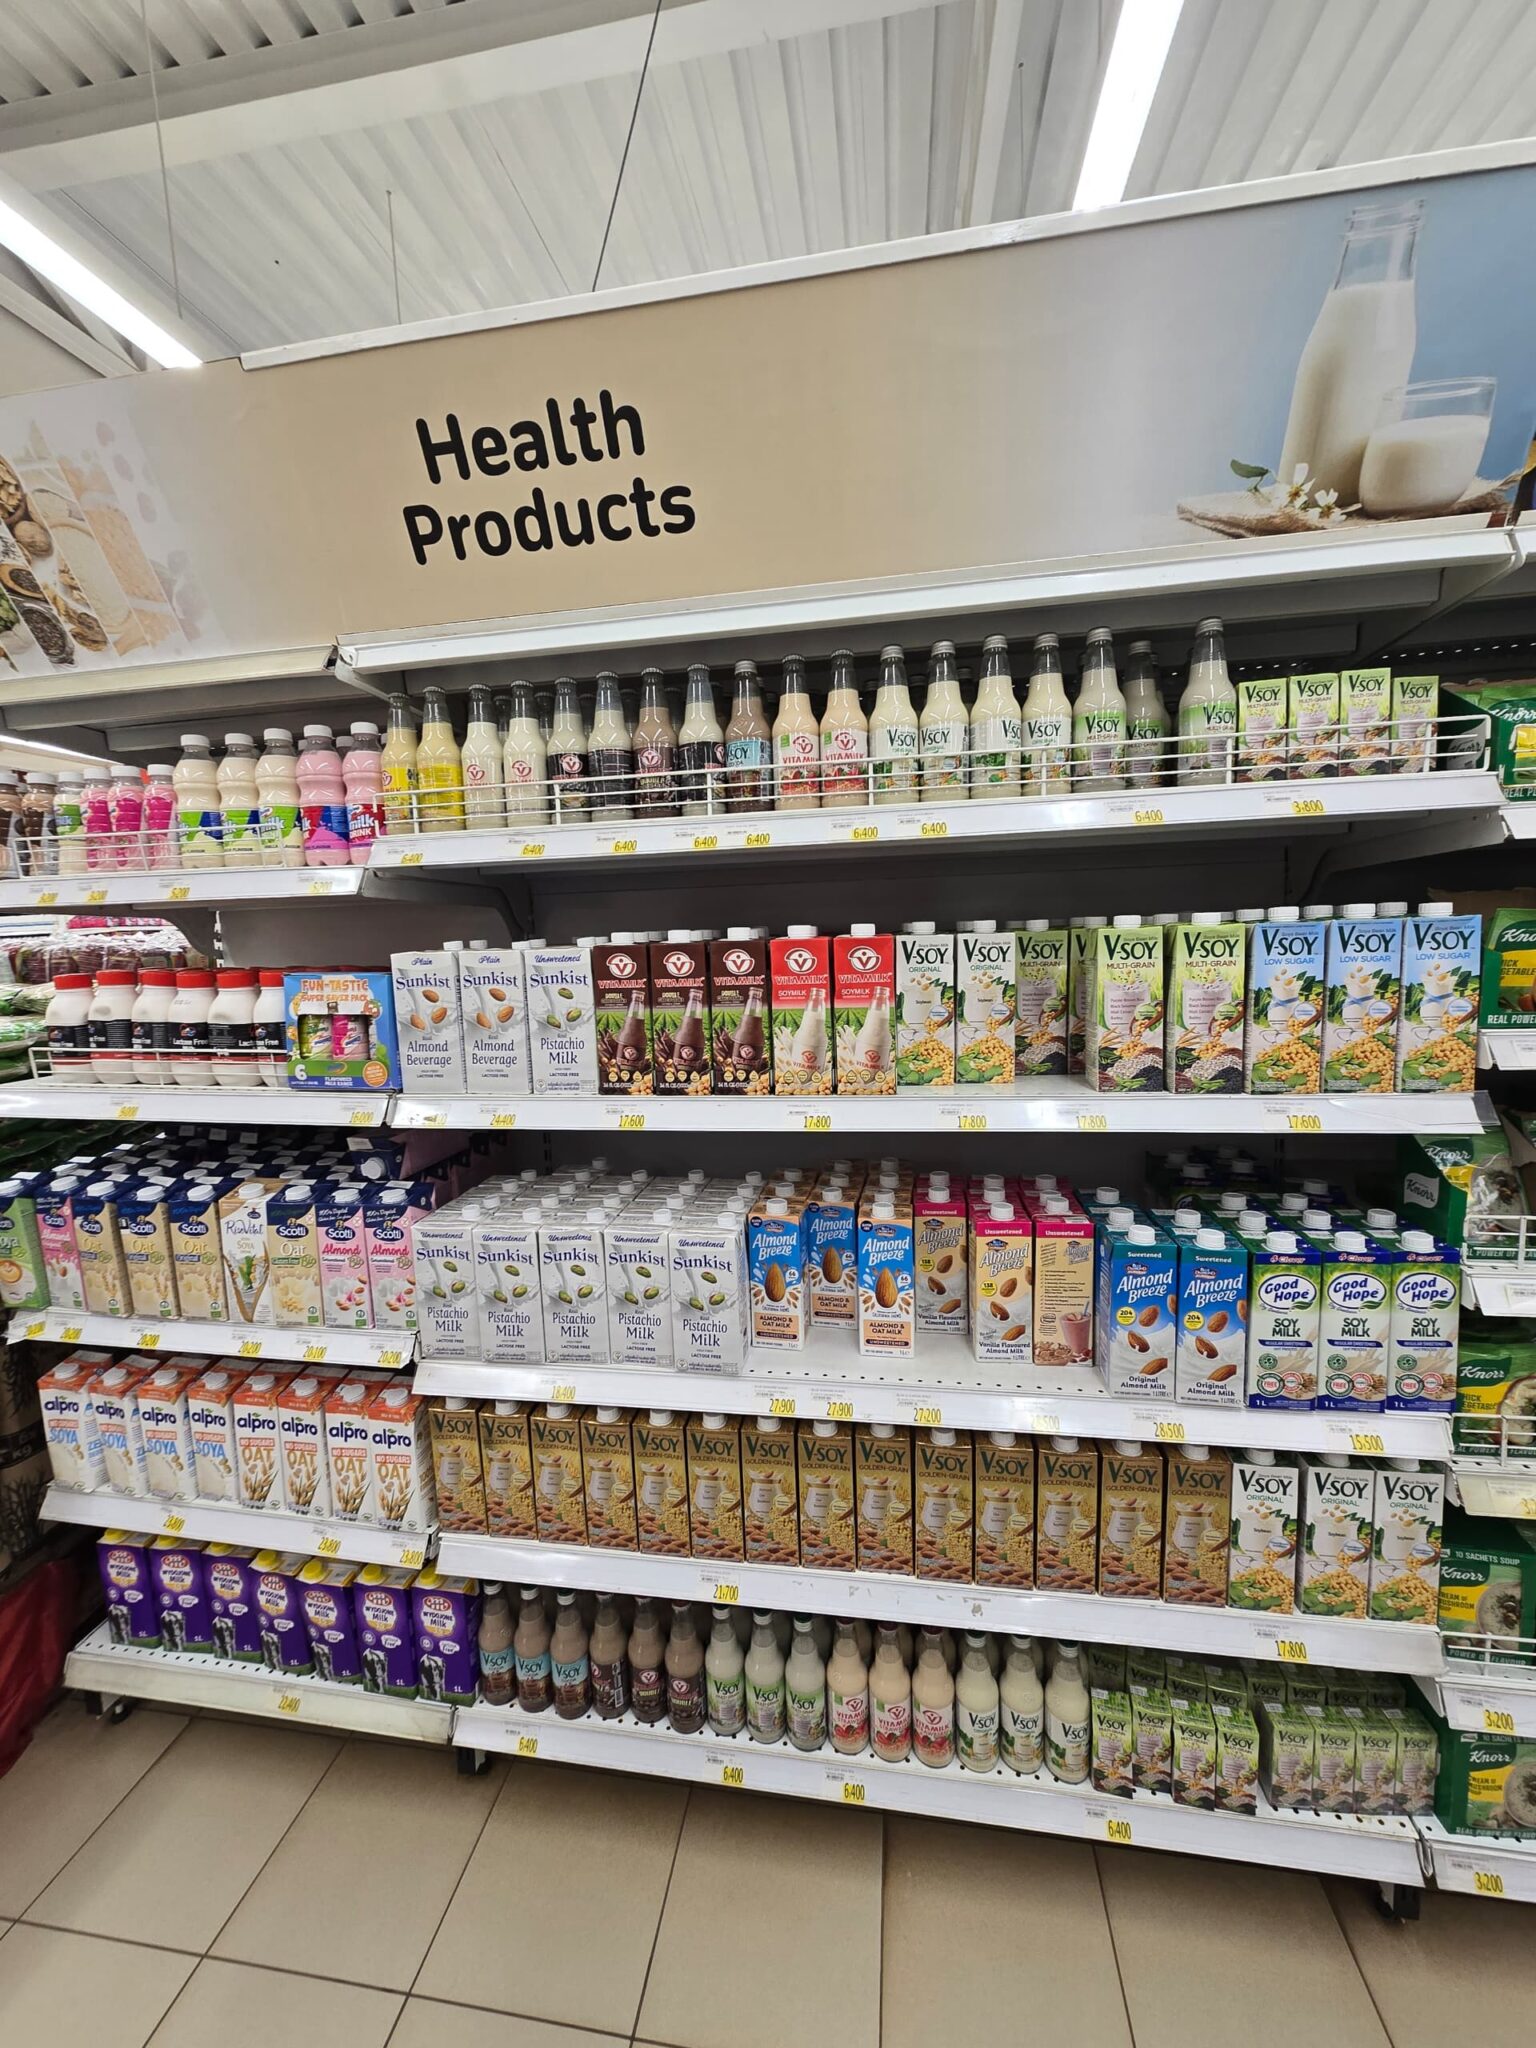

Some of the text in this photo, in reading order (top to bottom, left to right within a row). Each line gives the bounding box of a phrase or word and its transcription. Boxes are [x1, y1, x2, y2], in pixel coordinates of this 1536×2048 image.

[416, 389, 645, 484] Health
[403, 477, 695, 565] Products
[1262, 929, 1318, 956] V-SOY
[1338, 926, 1396, 953] V-SOY
[1415, 923, 1474, 951] V-SOY
[901, 940, 948, 964] V-SOY
[963, 939, 1009, 963] V-SOY
[1018, 937, 1063, 960] V-SOY
[1104, 934, 1158, 960] V-SOY
[1184, 932, 1239, 959] V-SOY
[1186, 960, 1236, 968] MULTI-GRAIN
[1340, 955, 1358, 963] LOW
[1416, 952, 1471, 960] LOW SUGAR
[396, 975, 451, 990] Sunkist
[463, 973, 519, 988] Sunkist
[530, 972, 589, 988] Sunkist
[778, 990, 806, 998] SOYMILK
[842, 988, 870, 996] SOYMILK
[1487, 1015, 1509, 1024] REAL
[408, 1039, 448, 1052] Almond
[472, 1039, 514, 1052] Almond
[541, 1038, 584, 1051] Pistachio
[406, 1054, 452, 1067] Beverage
[472, 1053, 517, 1067] Beverage
[549, 1051, 578, 1064] Milk
[295, 1064, 307, 1080] 6
[811, 1218, 852, 1233] Almond
[614, 1235, 659, 1244] Unsweetened
[678, 1239, 724, 1248] Unsweetened
[752, 1232, 797, 1249] Almond
[863, 1237, 909, 1254] Almond
[416, 1246, 470, 1262] Sunkist
[478, 1250, 533, 1266] Sunkist
[543, 1248, 600, 1266] Sunkist
[608, 1251, 665, 1268] Sunkist
[758, 1244, 792, 1260] Breeze
[869, 1249, 904, 1265] Breeze
[980, 1244, 1029, 1268] Almond
[673, 1256, 732, 1274] Sunkist
[1117, 1270, 1172, 1293] Almond
[1184, 1275, 1242, 1298] Almond
[1264, 1279, 1299, 1294] Good
[1333, 1278, 1368, 1293] Good
[1402, 1278, 1436, 1292] Good
[1128, 1282, 1168, 1304] Breeze
[1196, 1288, 1237, 1308] Breeze
[1274, 1289, 1309, 1303] Hope
[1343, 1289, 1378, 1302] Hope
[1412, 1289, 1448, 1302] Hope
[427, 1307, 468, 1320] Pistachio
[488, 1311, 530, 1325] Pistachio
[552, 1313, 595, 1325] Pistachio
[618, 1313, 661, 1326] Pistachio
[435, 1320, 462, 1332] Milk
[496, 1324, 524, 1337] Milk
[683, 1319, 727, 1333] Pistachio
[1274, 1318, 1299, 1328] SOY
[1344, 1318, 1368, 1328] SOY
[1413, 1318, 1437, 1328] SOY
[561, 1325, 588, 1338] Milk
[626, 1326, 654, 1340] Milk
[1272, 1328, 1300, 1337] MILK
[1341, 1328, 1370, 1337] MILK
[1411, 1328, 1440, 1337] MILK
[691, 1333, 720, 1347] Milk
[1460, 1366, 1505, 1380] Knorr
[1196, 1382, 1227, 1390] Original
[44, 1396, 79, 1414] alpro
[96, 1402, 125, 1419] alpro
[142, 1407, 176, 1426] alpro
[192, 1409, 226, 1427] alpro
[237, 1413, 276, 1432] alpro
[432, 1414, 472, 1434] V-SOY
[282, 1417, 318, 1436] alpro
[329, 1422, 368, 1442] alpro
[482, 1418, 523, 1438] V-SOY
[534, 1422, 575, 1444] V-SOY
[373, 1429, 411, 1448] alpro
[584, 1427, 625, 1448] V-SOY
[636, 1431, 679, 1452] V-SOY
[691, 1433, 733, 1456] V-SOY
[746, 1436, 790, 1458] V-SOY
[802, 1440, 847, 1464] V-SOY
[860, 1441, 905, 1464] V-SOY
[921, 1450, 967, 1473] V-SOY
[980, 1451, 1029, 1476] V-SOY
[1043, 1456, 1093, 1480] V-SOY
[1108, 1462, 1158, 1486] V-SOY
[1174, 1465, 1225, 1490] V-SOY
[1239, 1469, 1293, 1497] V-SOY
[1314, 1472, 1368, 1499] V-SOY
[1383, 1476, 1439, 1502] V-SOY
[1466, 1552, 1497, 1562] SACHETS
[1441, 1566, 1485, 1581] Knorr
[1469, 1750, 1512, 1763] Knorr
